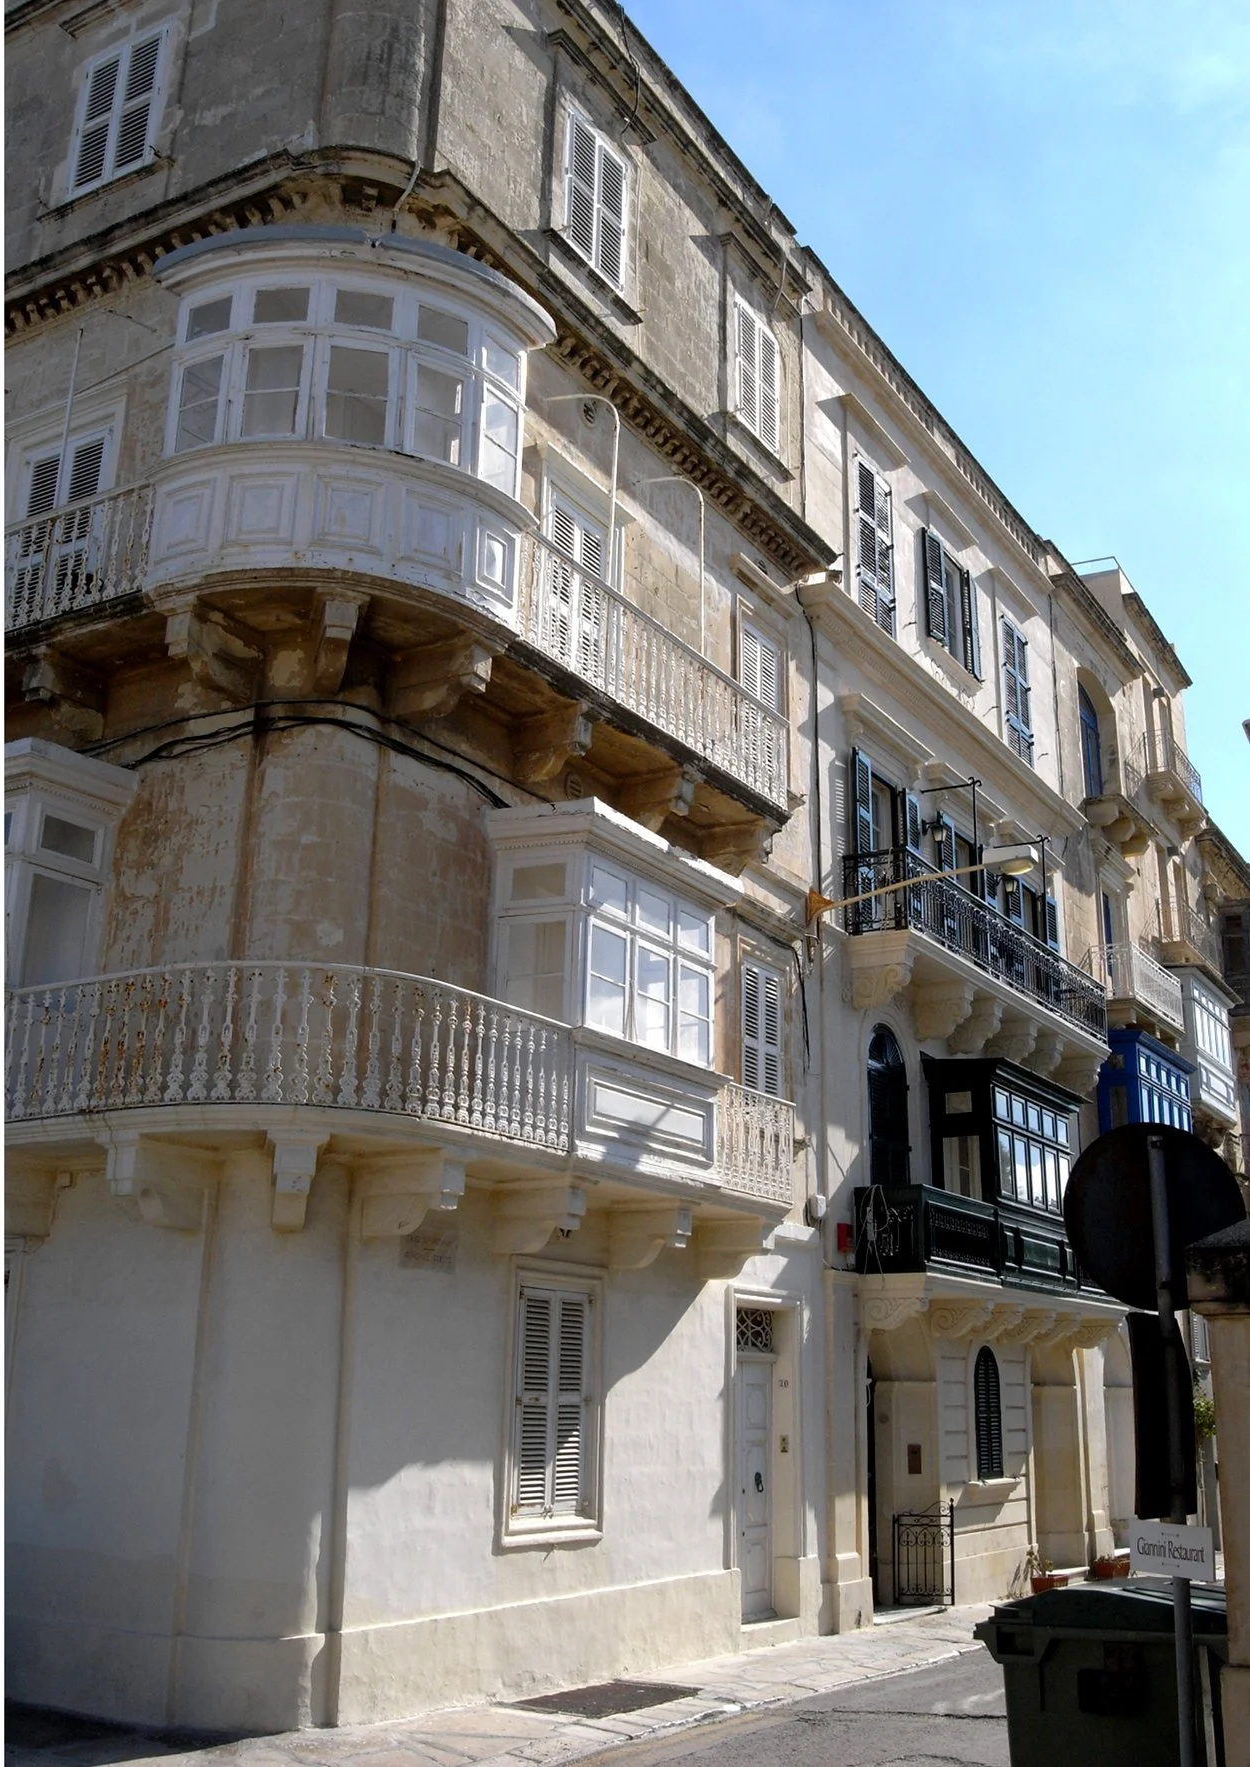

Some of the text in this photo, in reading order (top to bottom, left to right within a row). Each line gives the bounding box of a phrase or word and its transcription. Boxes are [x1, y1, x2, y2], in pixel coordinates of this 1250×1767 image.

[779, 1379, 789, 1389] 20
[1136, 1536, 1205, 1563] Giannini Restaurant
